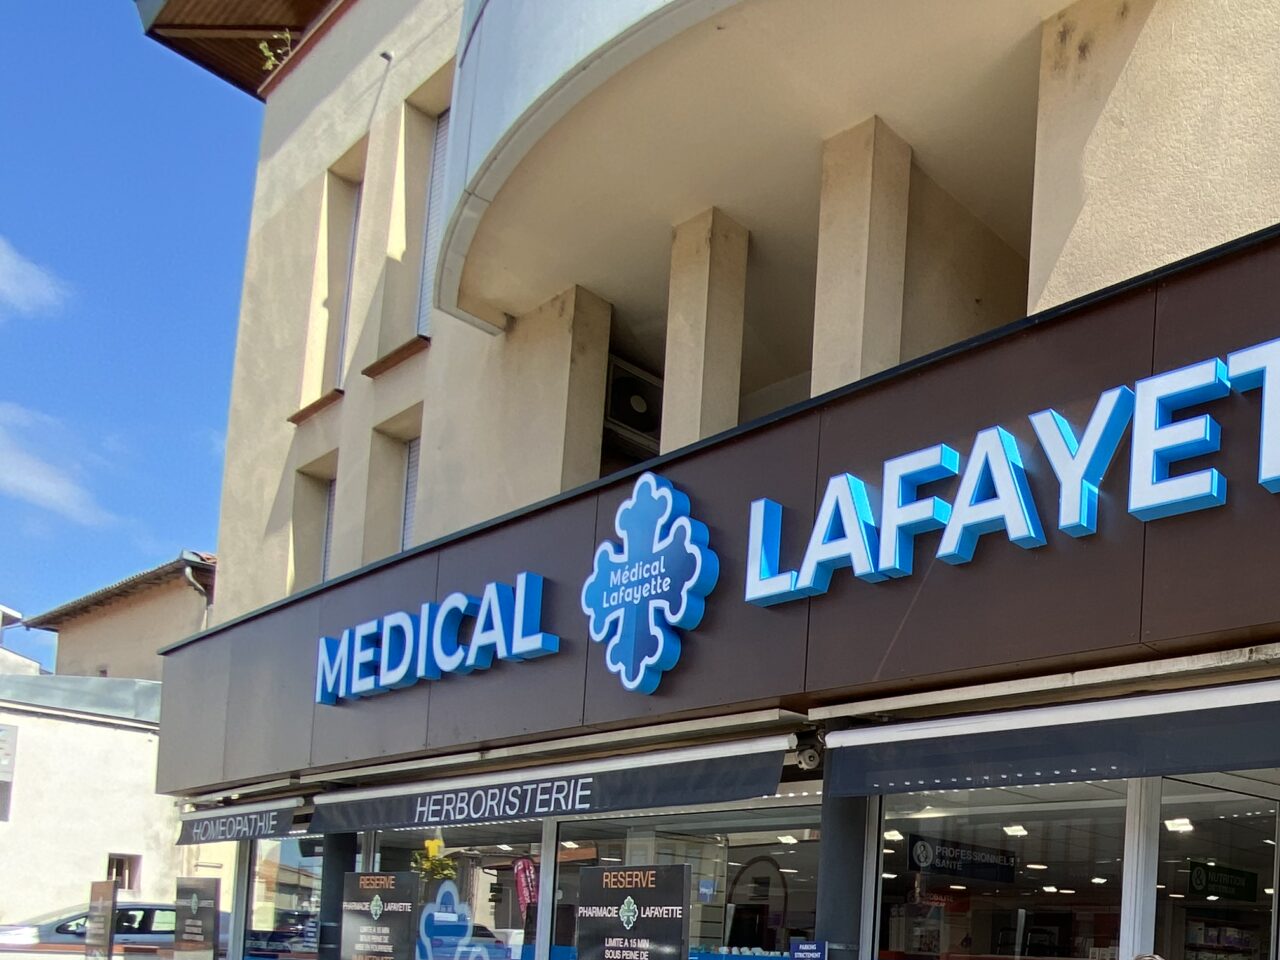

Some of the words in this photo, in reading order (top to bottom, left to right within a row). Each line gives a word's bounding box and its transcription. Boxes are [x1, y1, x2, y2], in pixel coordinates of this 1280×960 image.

[609, 556, 666, 587] Médical
[602, 576, 671, 609] Lafayette
[316, 571, 559, 706] MEDICAL
[415, 777, 593, 823] HERBORISTERIE
[192, 811, 278, 840] HOMEOPATHIE
[602, 871, 656, 888] RESERVE
[578, 906, 618, 917] PHARMACIE
[640, 906, 683, 918] LAFAYETTE
[604, 938, 624, 947] LIMITE
[629, 939, 636, 947] 15
[604, 950, 621, 959] SOUS
[622, 951, 639, 959] PEINE
[639, 952, 649, 960] DE
